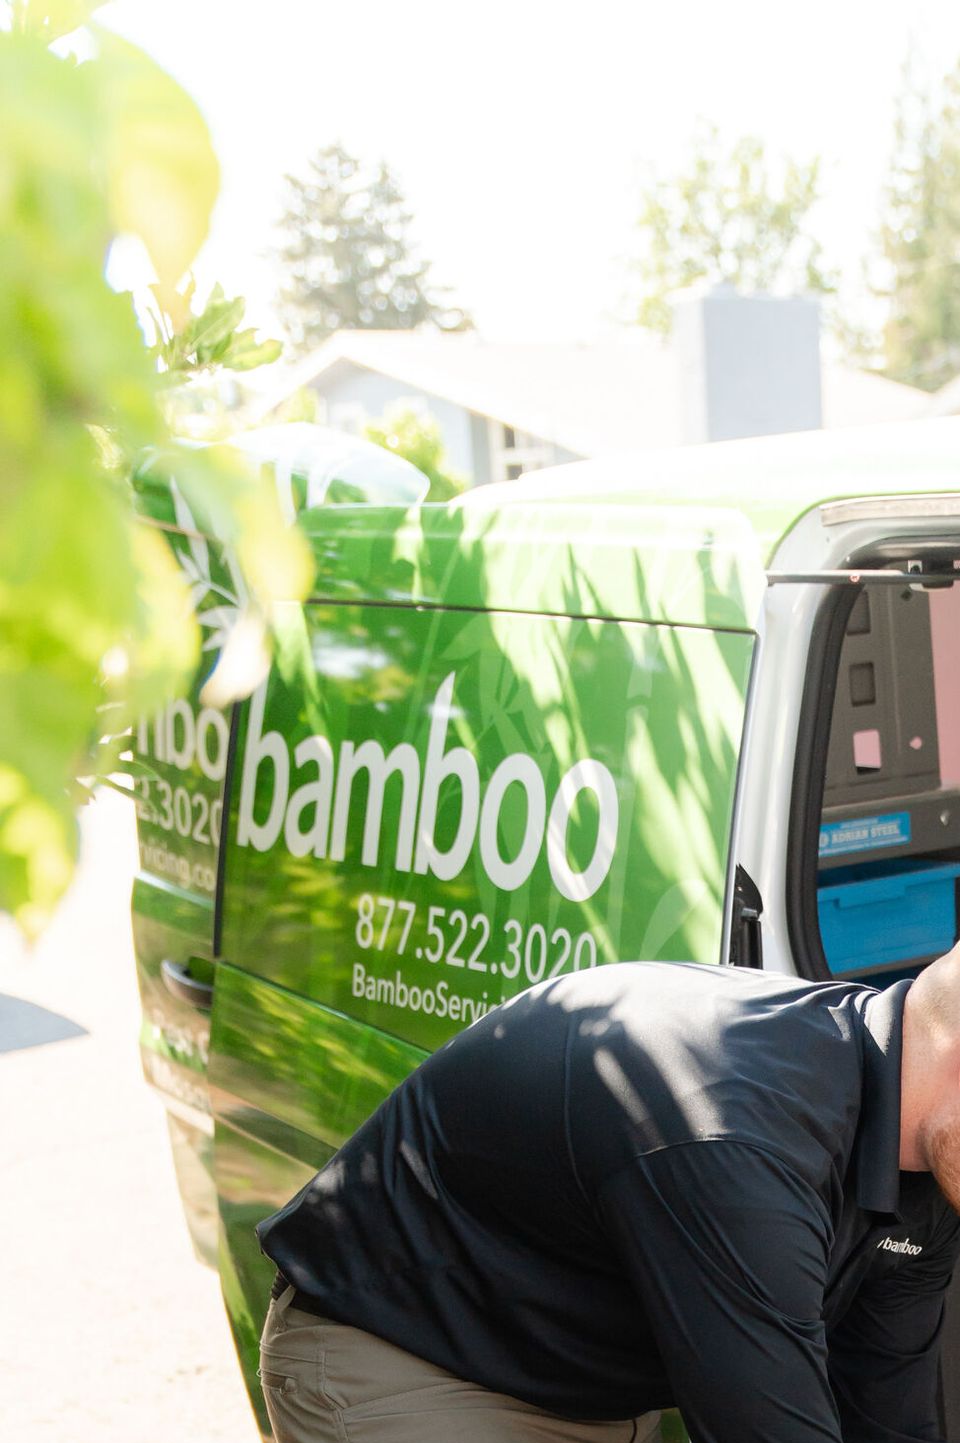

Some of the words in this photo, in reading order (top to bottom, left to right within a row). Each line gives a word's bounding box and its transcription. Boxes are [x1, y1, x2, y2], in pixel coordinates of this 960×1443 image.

[236, 670, 619, 902] bamboo
[831, 828, 869, 845] ADRIAN
[870, 822, 900, 838] STEEL
[355, 893, 597, 984] 877.522.3020
[352, 963, 506, 1024] BambooServi
[882, 1236, 923, 1256] bamboo
